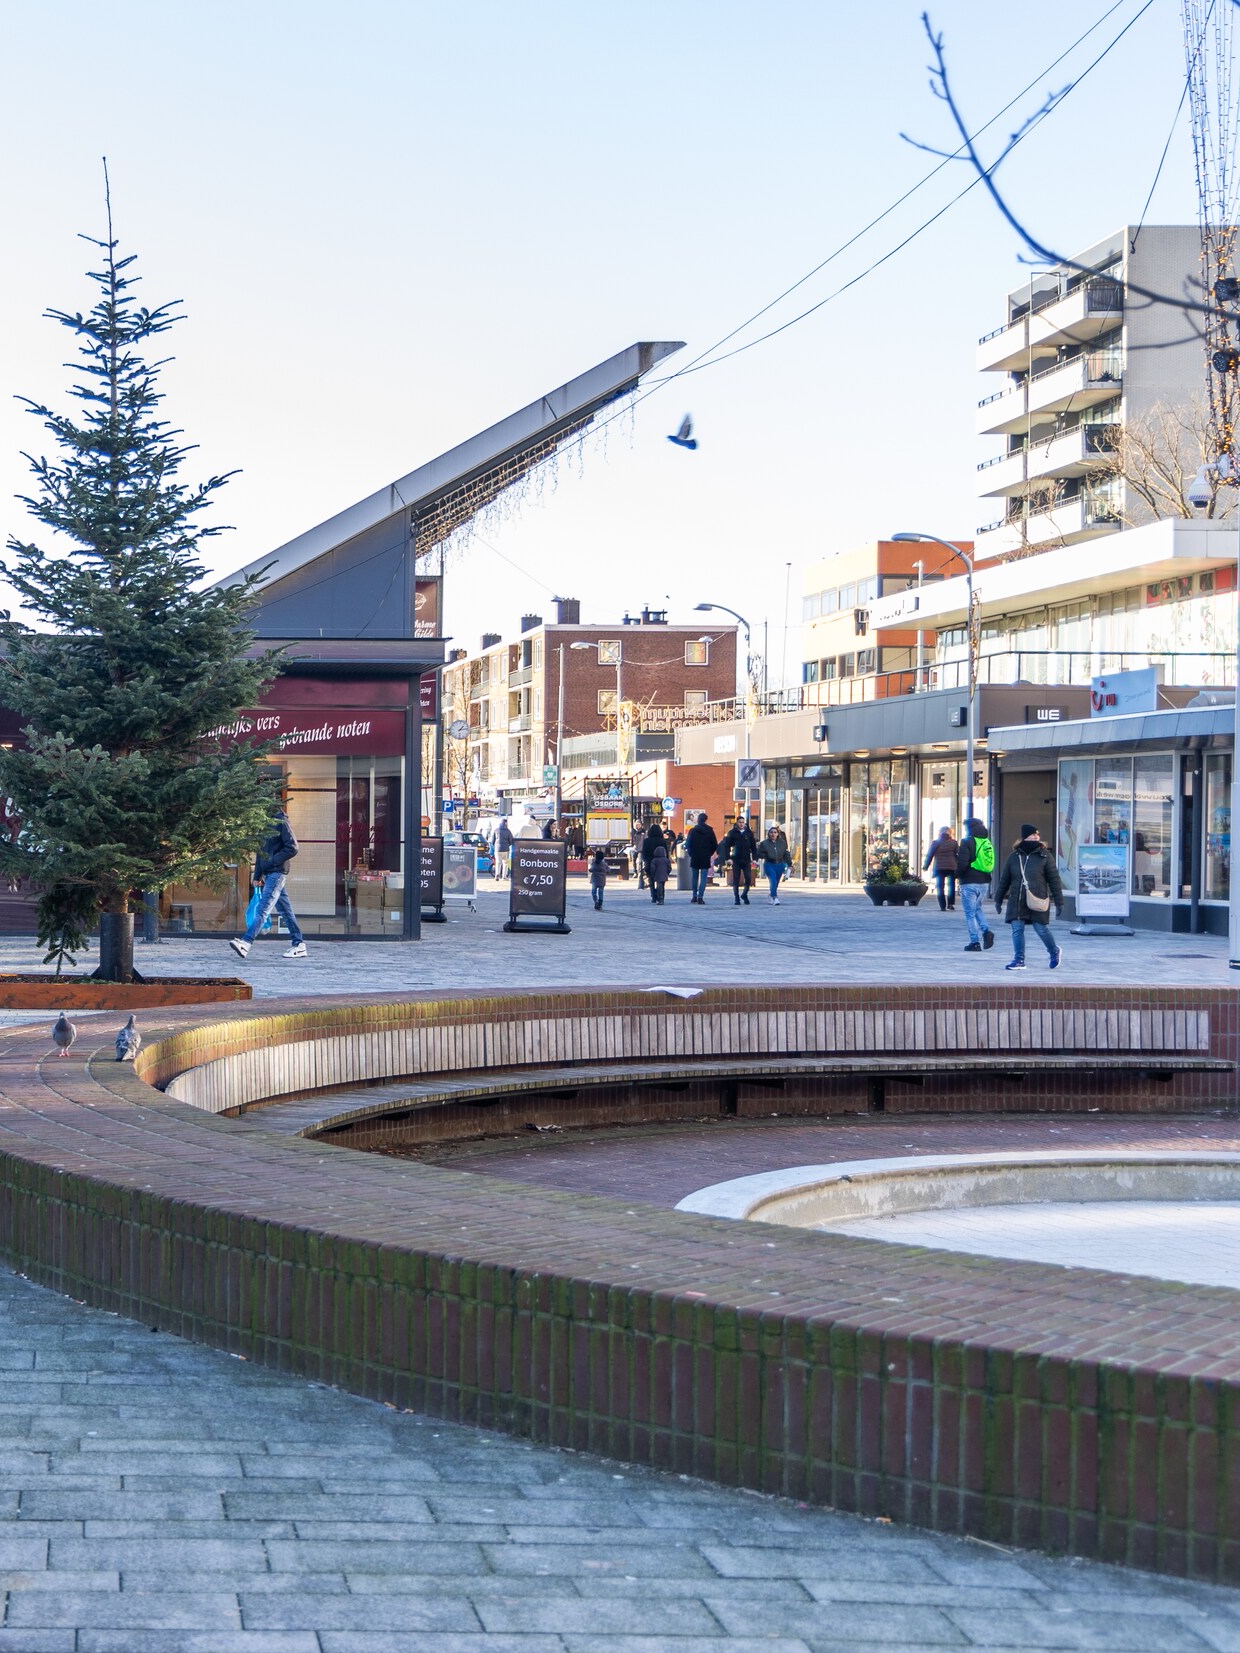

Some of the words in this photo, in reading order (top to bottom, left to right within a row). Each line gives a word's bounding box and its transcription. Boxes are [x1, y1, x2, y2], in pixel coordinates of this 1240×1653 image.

[1037, 709, 1060, 720] WE
[196, 716, 251, 740] agelijks
[256, 715, 280, 731] vers
[279, 722, 333, 750] gebrande
[337, 720, 370, 738] noten
[443, 802, 452, 811] P
[520, 847, 559, 855] Handgemaakte
[520, 859, 559, 868] Bonbons
